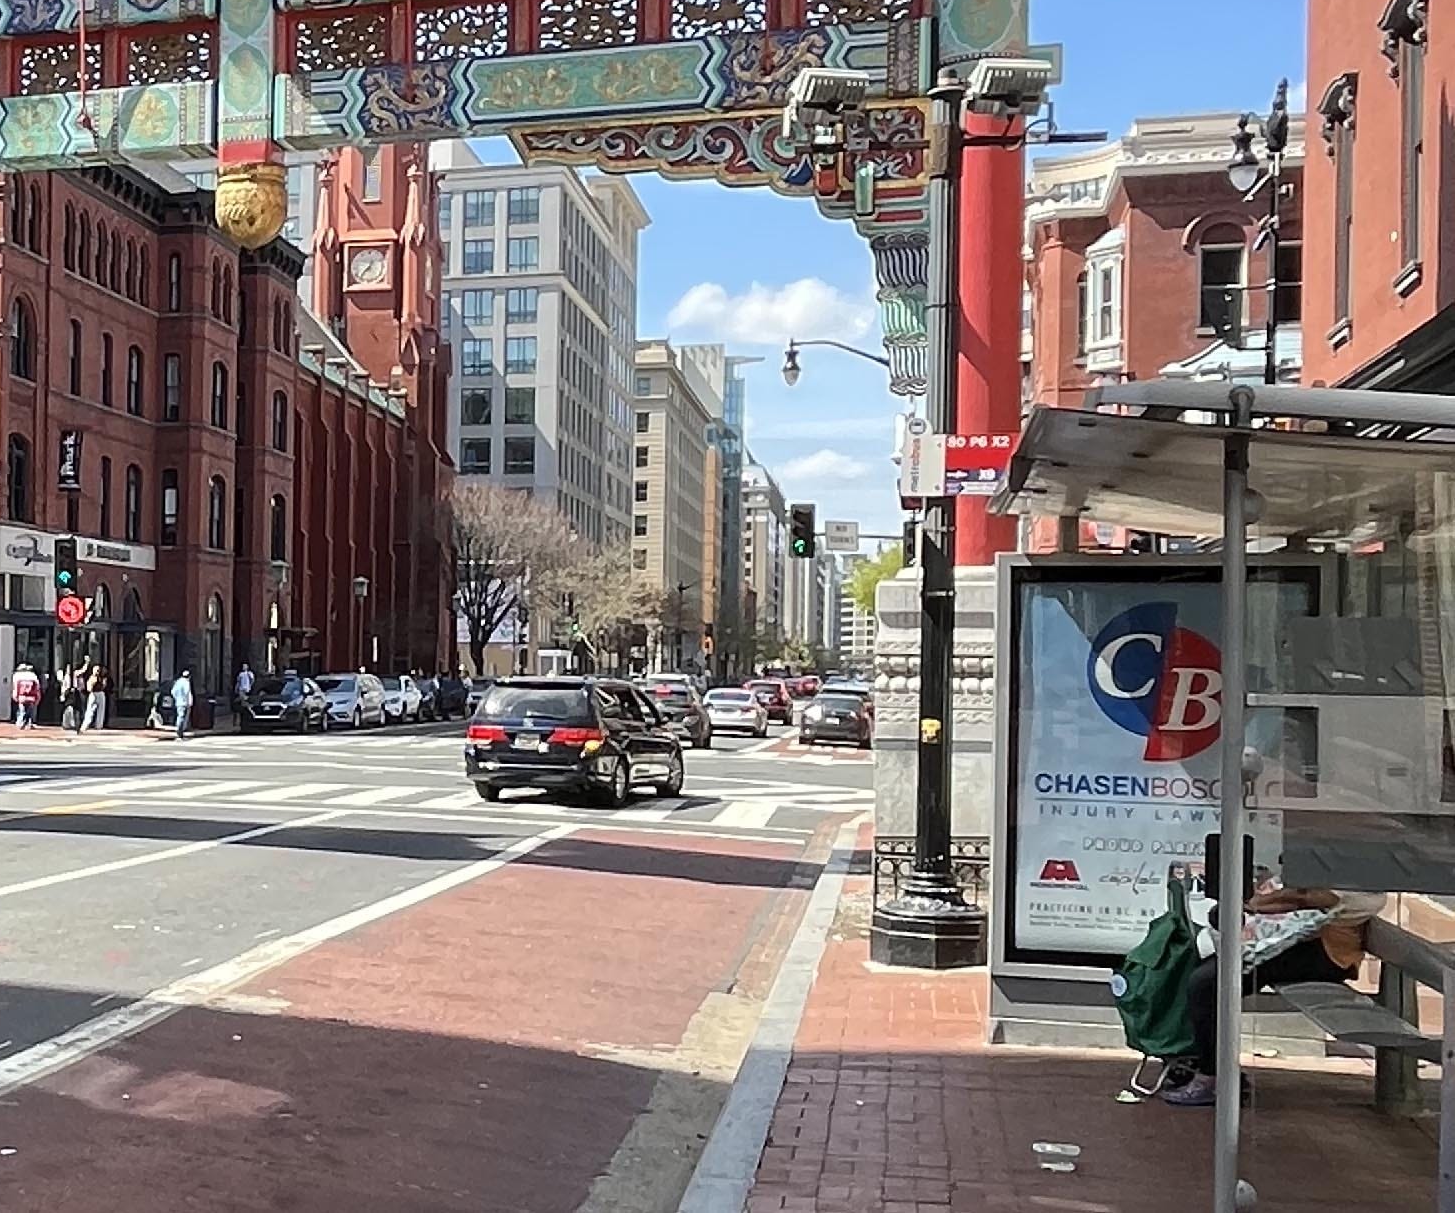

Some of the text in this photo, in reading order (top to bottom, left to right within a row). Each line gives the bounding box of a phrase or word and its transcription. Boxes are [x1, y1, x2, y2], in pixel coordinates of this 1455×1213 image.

[992, 435, 1010, 448] X2
[1039, 804, 1135, 820] INJURY
[1082, 837, 1144, 853] PROUD
